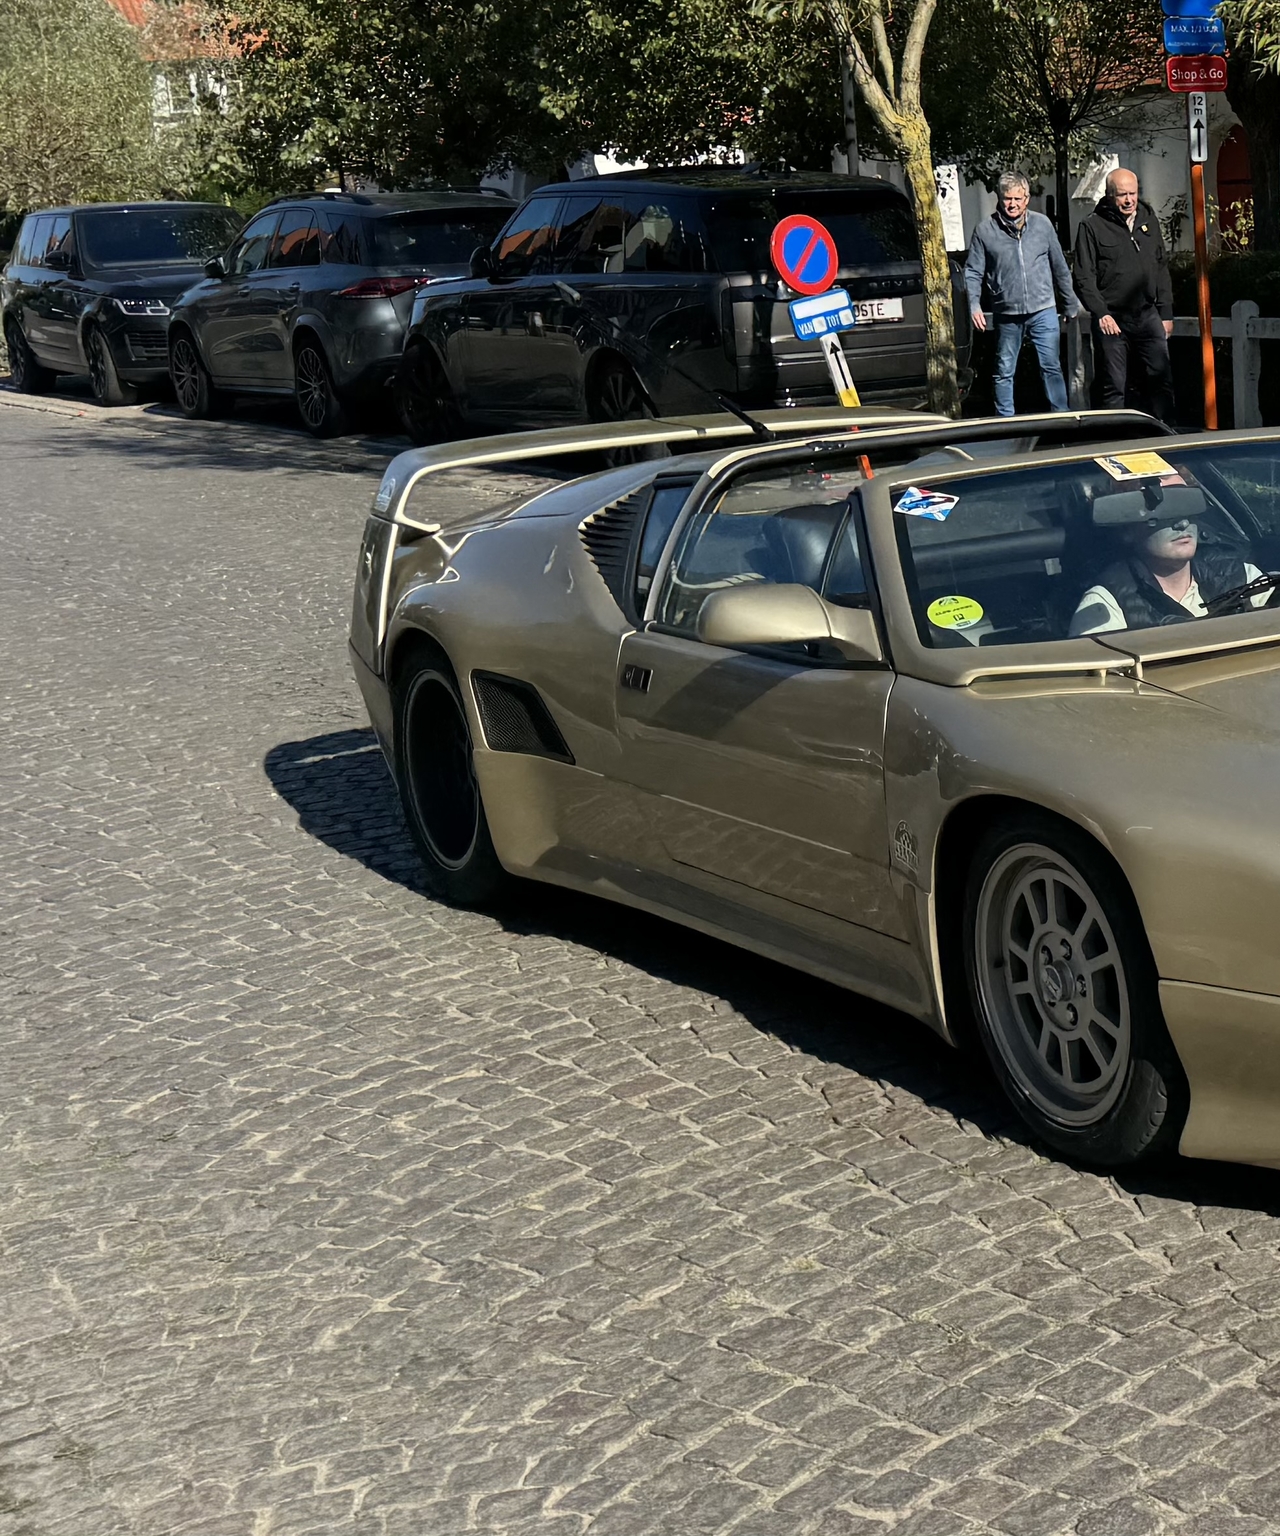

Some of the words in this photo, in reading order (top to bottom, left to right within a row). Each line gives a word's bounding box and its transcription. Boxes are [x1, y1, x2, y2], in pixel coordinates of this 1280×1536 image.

[1171, 69, 1197, 81] Shop
[1199, 69, 1207, 79] &
[1209, 69, 1223, 79] Go
[1192, 96, 1203, 106] 12
[798, 321, 814, 335] VAN
[826, 315, 840, 328] TOT
